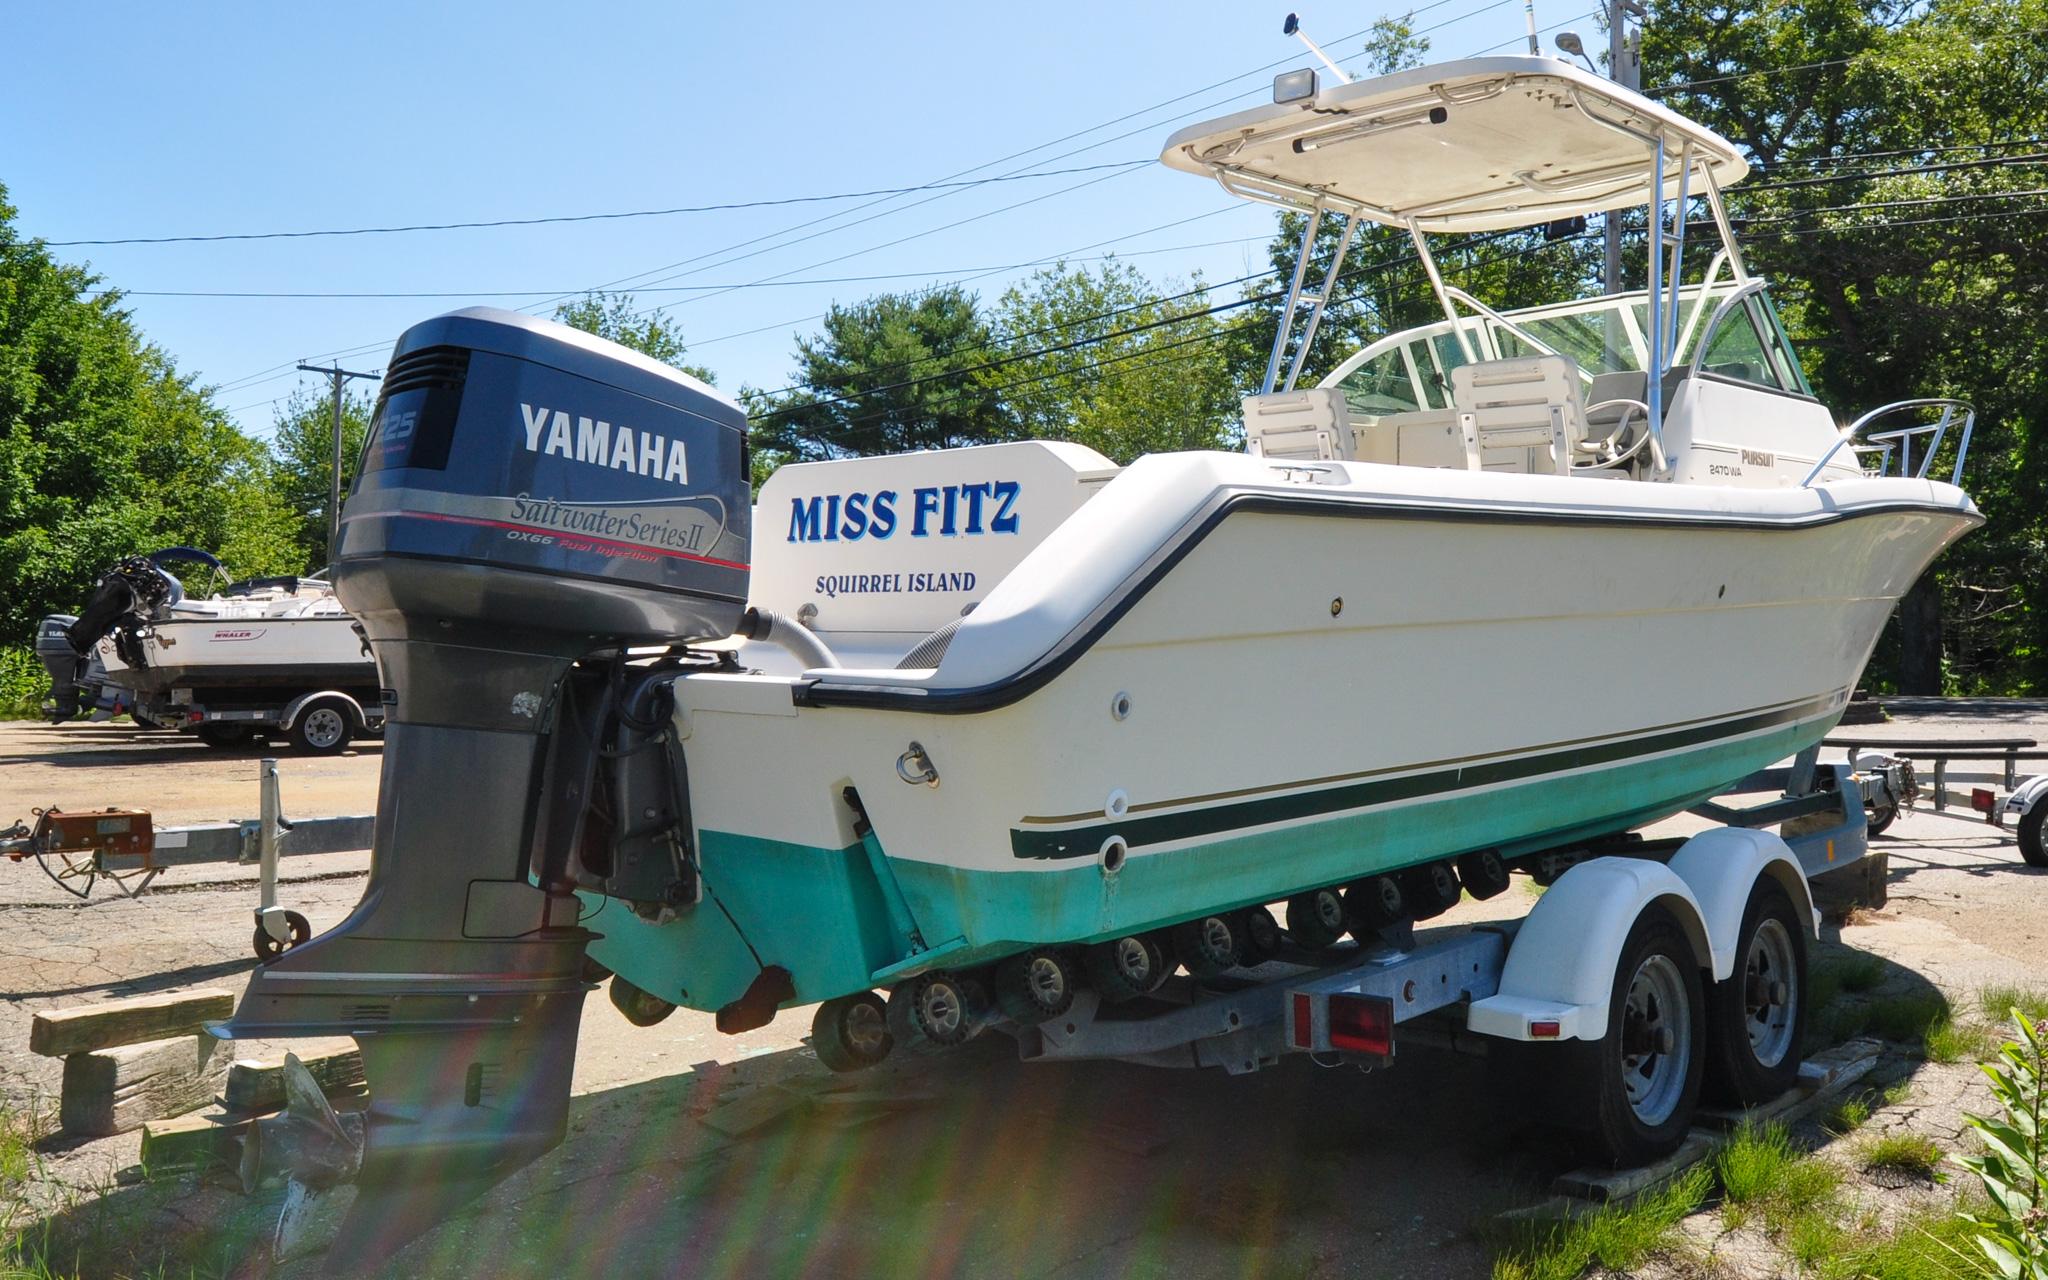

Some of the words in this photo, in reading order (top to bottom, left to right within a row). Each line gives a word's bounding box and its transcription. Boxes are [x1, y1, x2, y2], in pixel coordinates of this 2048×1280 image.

[519, 402, 689, 486] YAMAHA
[1741, 449, 1775, 468] PURSUIT
[787, 490, 897, 544] MISS
[911, 480, 1022, 538] FITZ
[506, 530, 555, 545] OX66
[815, 573, 902, 598] SQUIRREL
[908, 571, 977, 592] ISLAND
